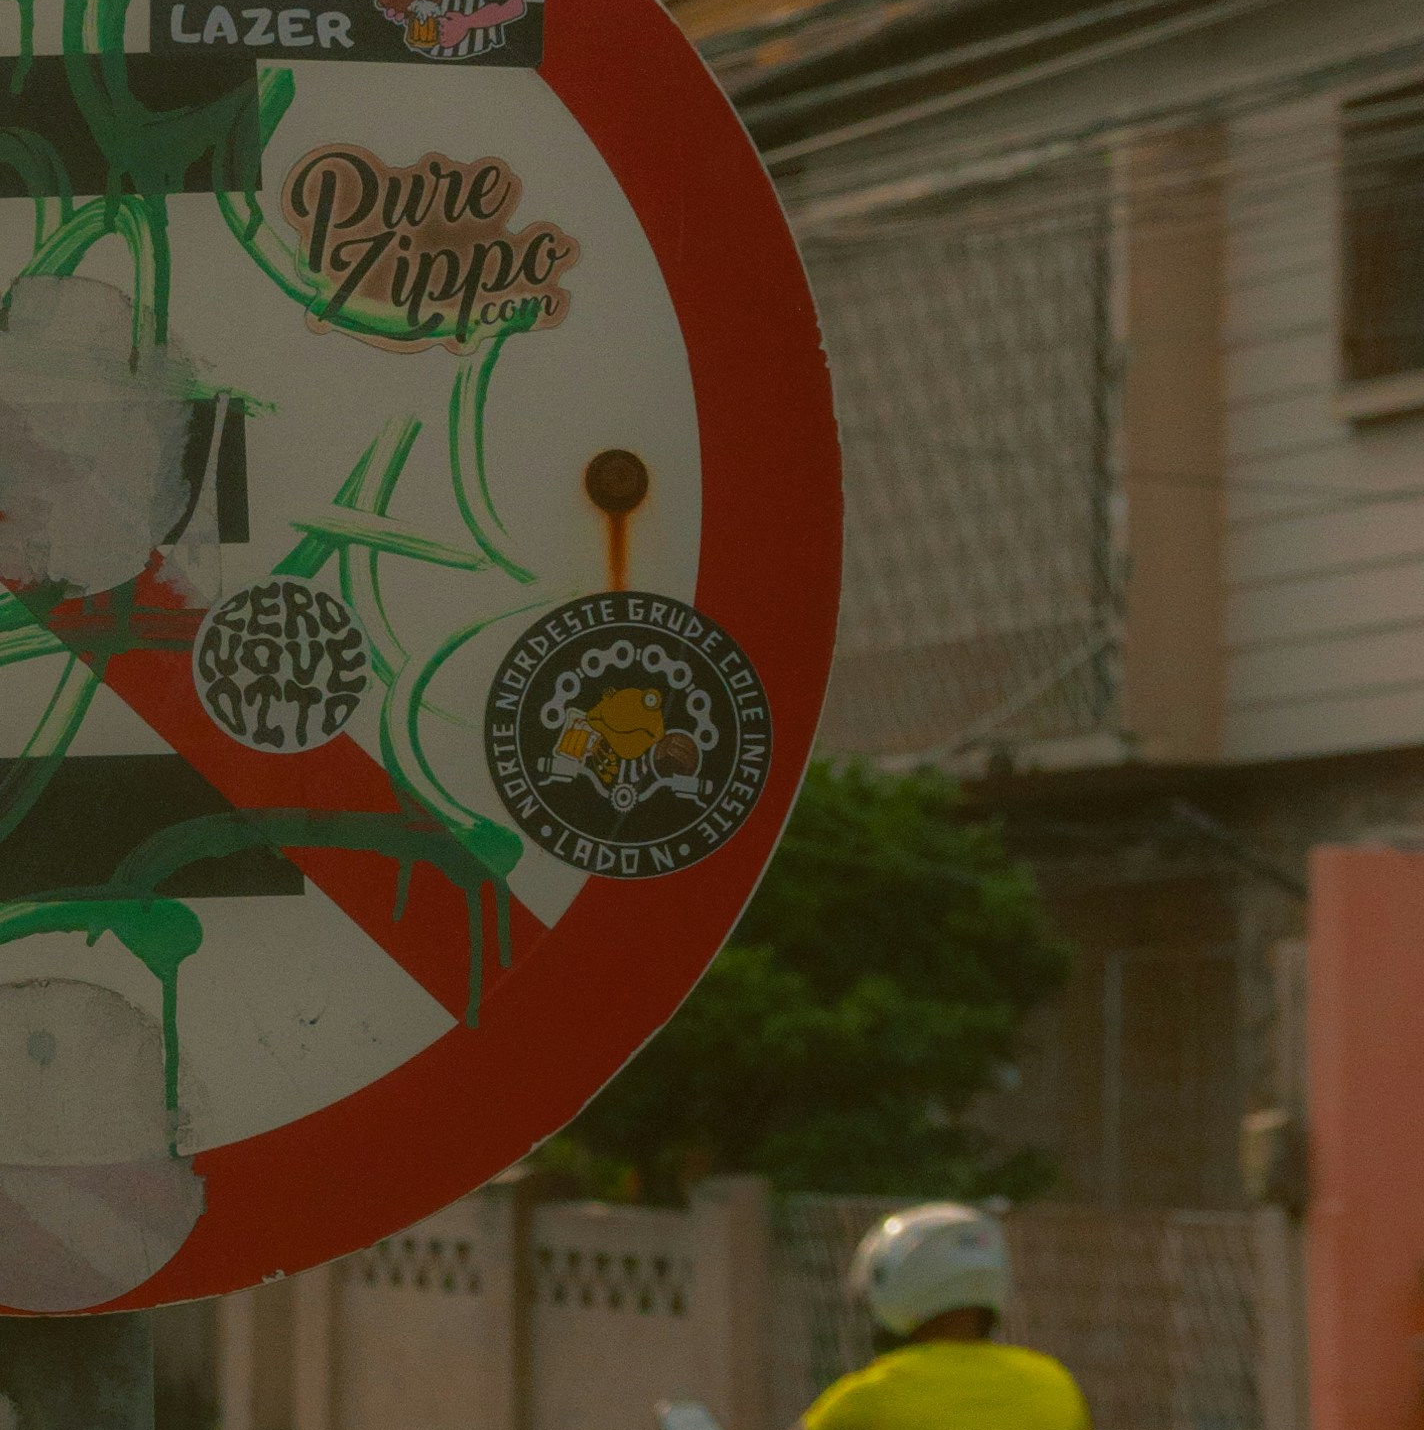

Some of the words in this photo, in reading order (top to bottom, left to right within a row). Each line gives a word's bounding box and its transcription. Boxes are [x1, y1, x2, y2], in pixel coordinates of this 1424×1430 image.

[170, 4, 356, 49] LAZER
[290, 151, 512, 274] Pure
[319, 230, 571, 344] Zippo
[212, 581, 352, 640] ZERO
[627, 598, 724, 653] GRUDE
[198, 626, 367, 694] NOVE
[495, 600, 616, 710] NORDESTE
[718, 651, 765, 723] COLE
[205, 675, 361, 748] OITO
[493, 723, 540, 819] NORTE
[697, 733, 767, 845] INFESTE
[552, 830, 639, 874] LADO
